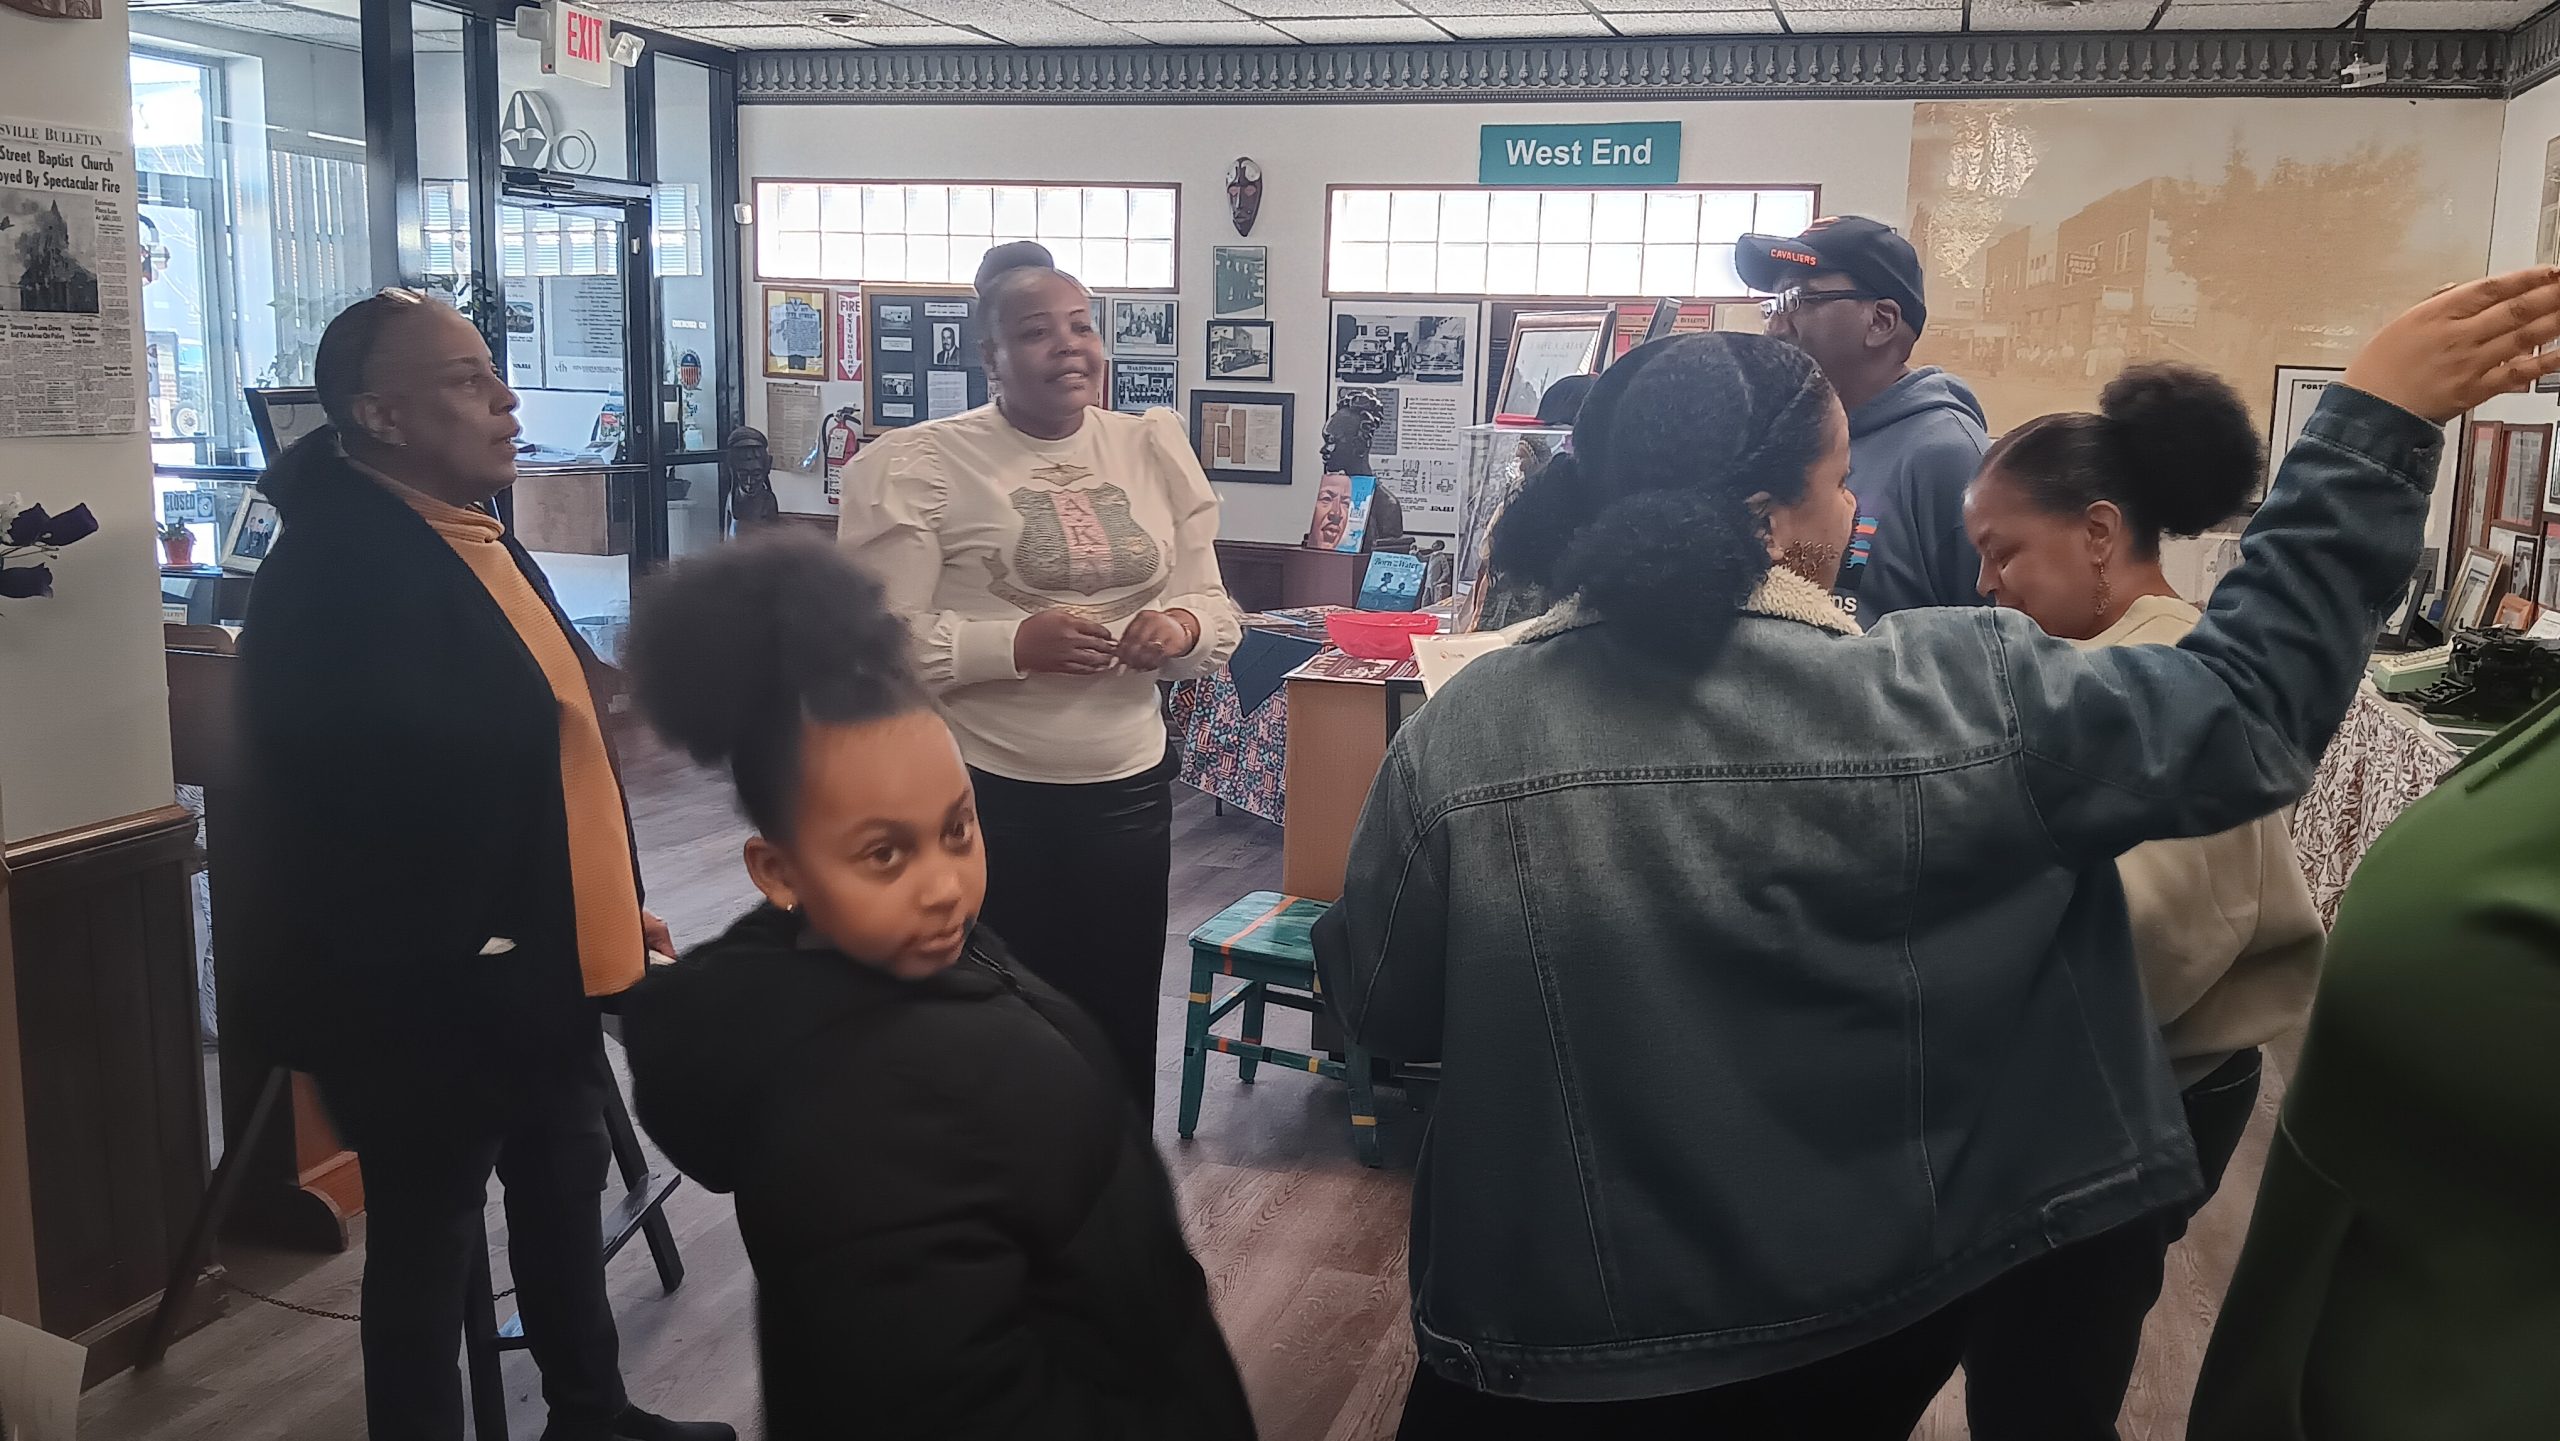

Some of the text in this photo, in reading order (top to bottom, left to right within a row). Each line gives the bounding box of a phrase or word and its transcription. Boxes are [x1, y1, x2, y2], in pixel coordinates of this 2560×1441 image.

[567, 11, 603, 63] EXIT
[45, 128, 102, 146] BULLETIN
[0, 145, 114, 172] Street Baptist Church
[1506, 138, 1652, 165] West End
[26, 170, 39, 188] By
[43, 171, 99, 190] Spectacular
[102, 177, 120, 193] Fire
[1770, 248, 1816, 266] CAVALIERS
[840, 301, 860, 312] FIRE
